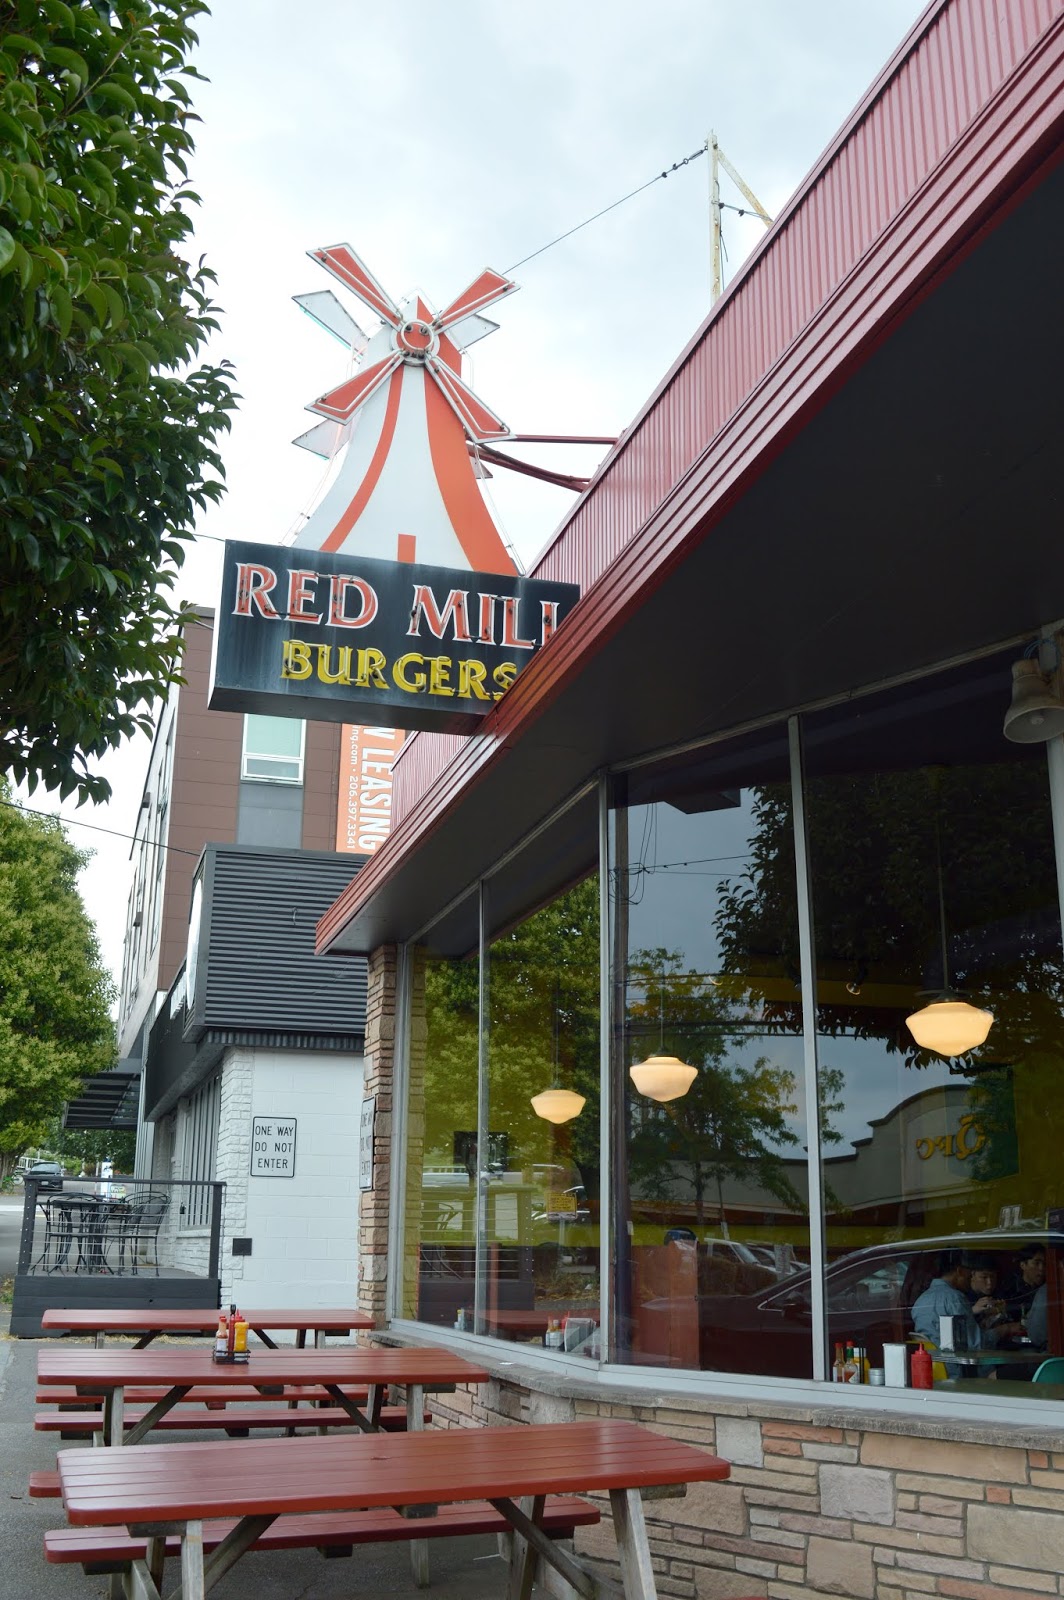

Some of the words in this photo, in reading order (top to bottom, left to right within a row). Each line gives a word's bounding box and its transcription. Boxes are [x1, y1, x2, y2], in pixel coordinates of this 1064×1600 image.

[231, 562, 379, 629] RED
[280, 639, 517, 701] BURGERS
[346, 775, 358, 849] 206.397.3341
[358, 747, 394, 850] LEASING
[254, 1125, 273, 1136] ONE
[277, 1126, 294, 1137] WAY
[254, 1141, 268, 1152] DO
[274, 1142, 293, 1153] NOT
[257, 1158, 289, 1169] ENTER
